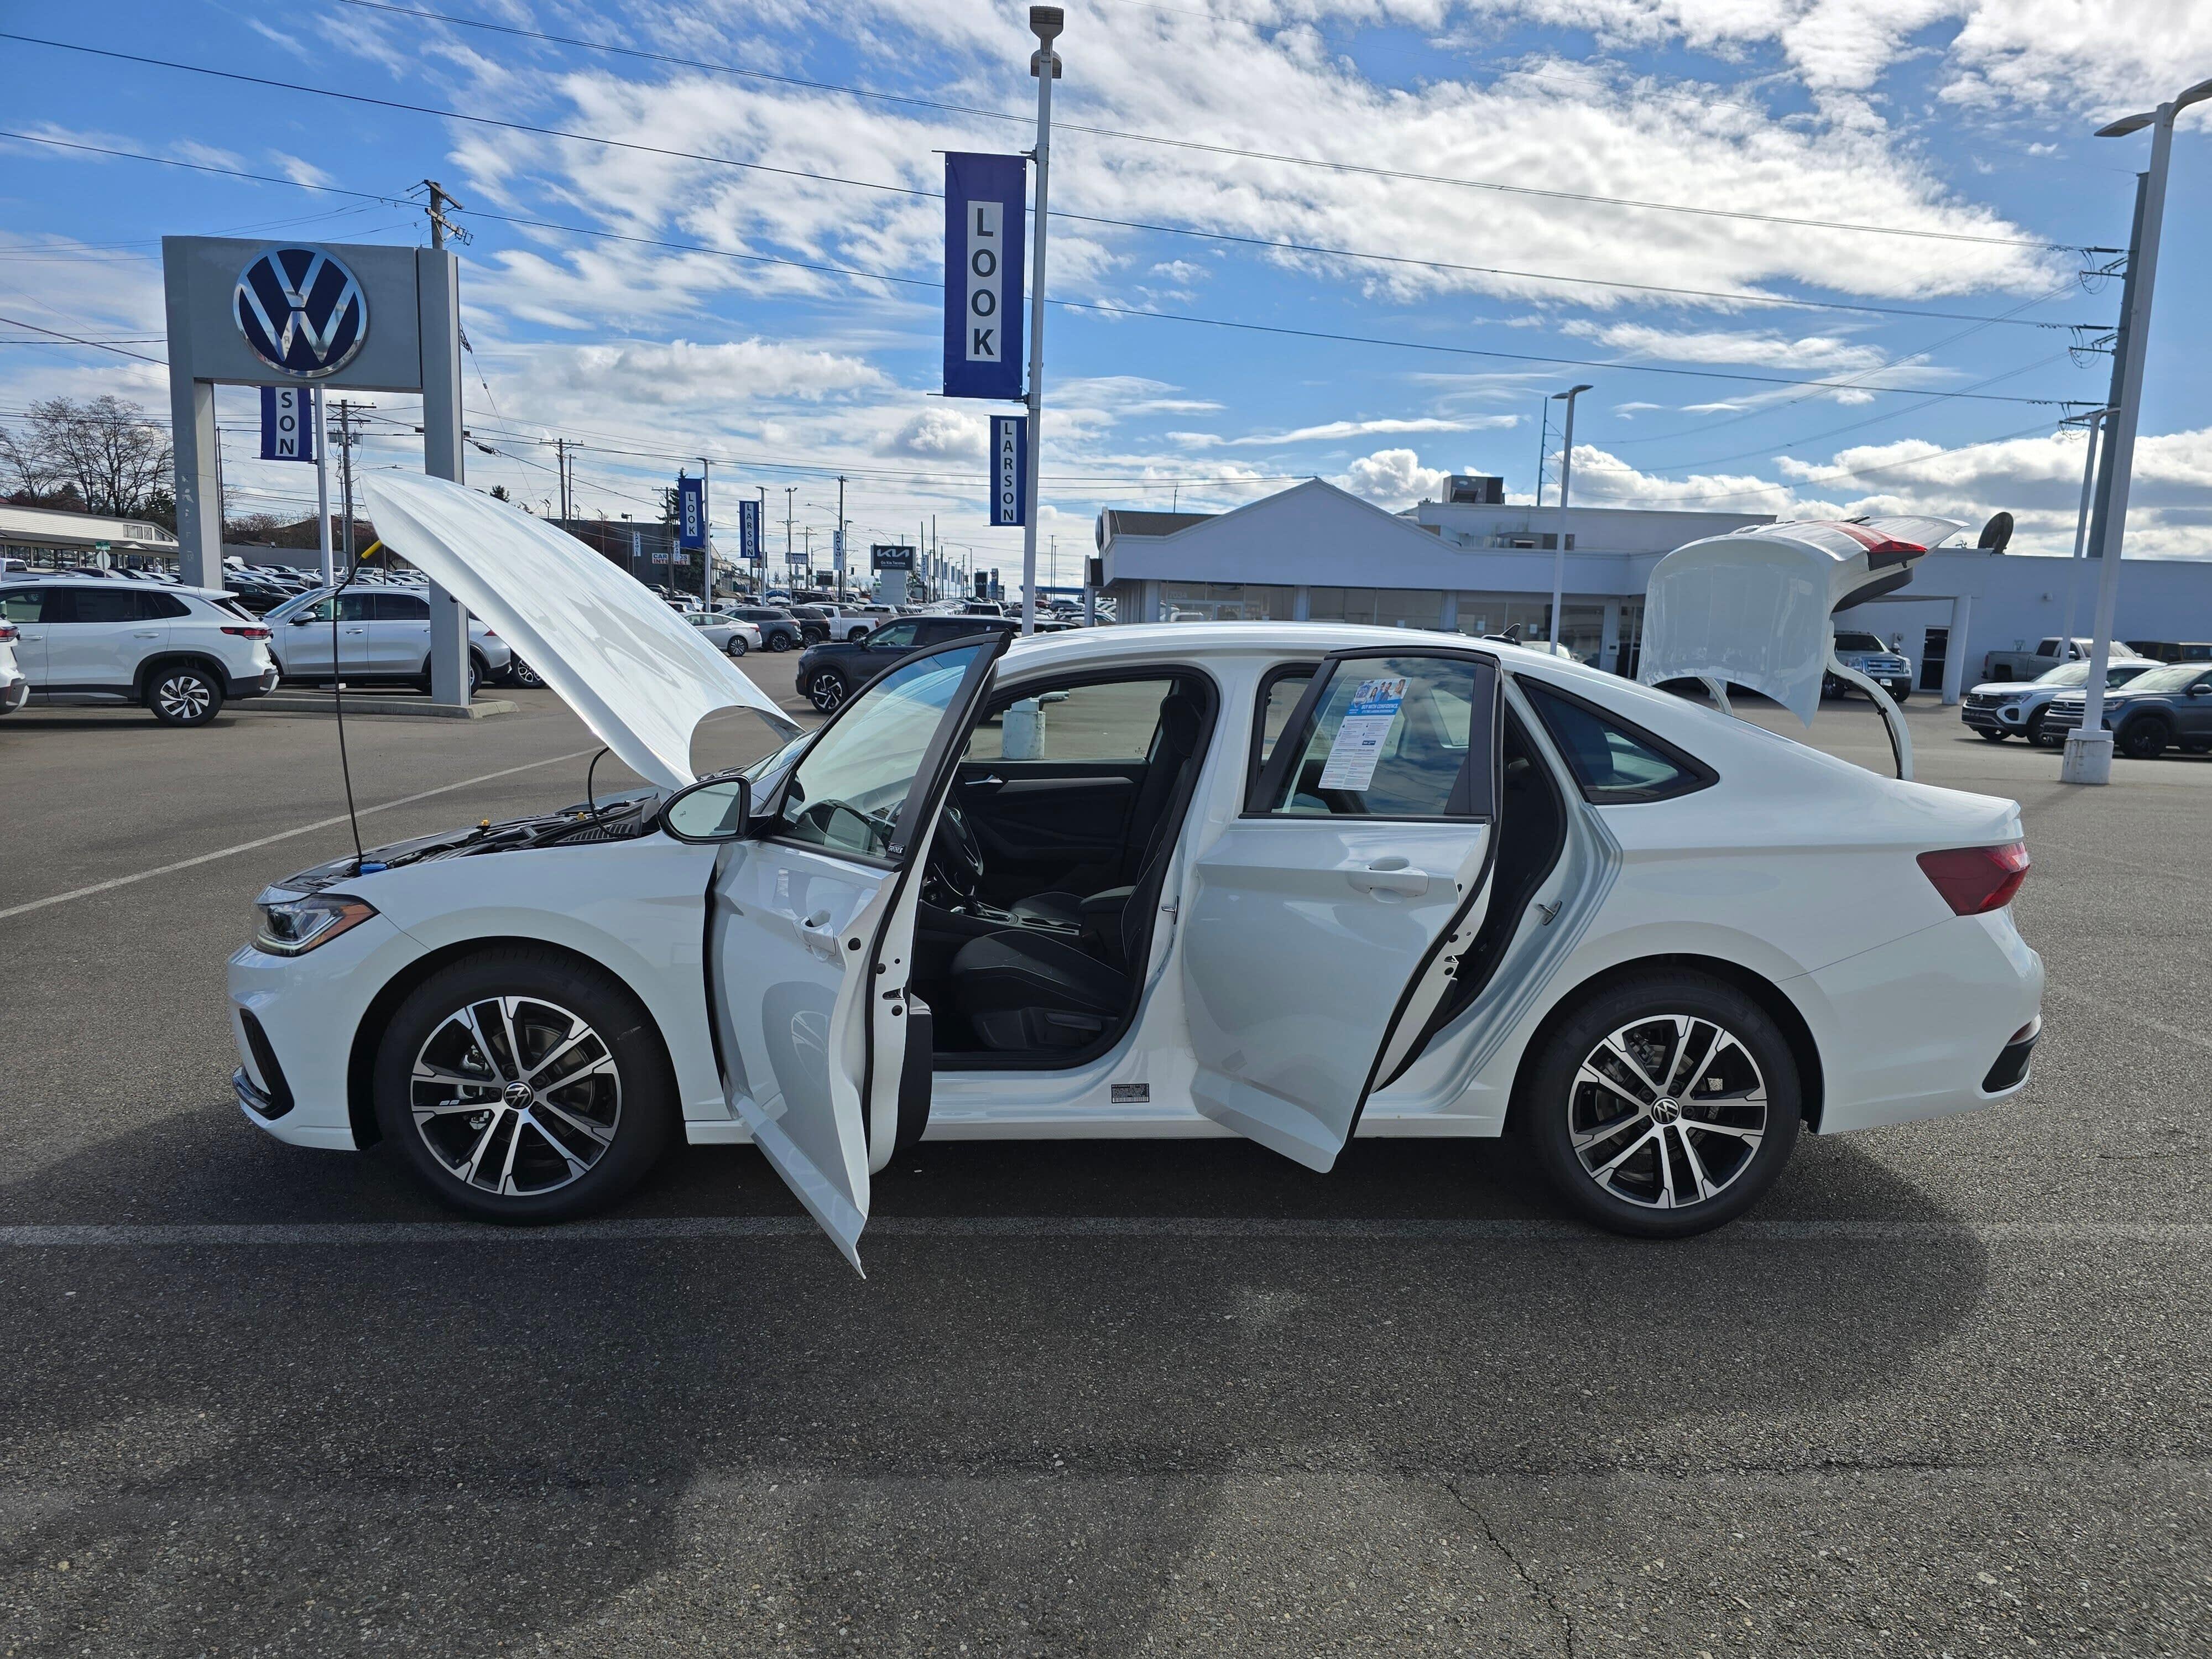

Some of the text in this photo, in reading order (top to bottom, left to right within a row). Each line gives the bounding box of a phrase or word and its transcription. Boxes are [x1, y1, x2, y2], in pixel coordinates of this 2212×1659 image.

[972, 208, 996, 356] LOOK
[1003, 422, 1014, 521] LARSON
[877, 549, 910, 557] KIA
